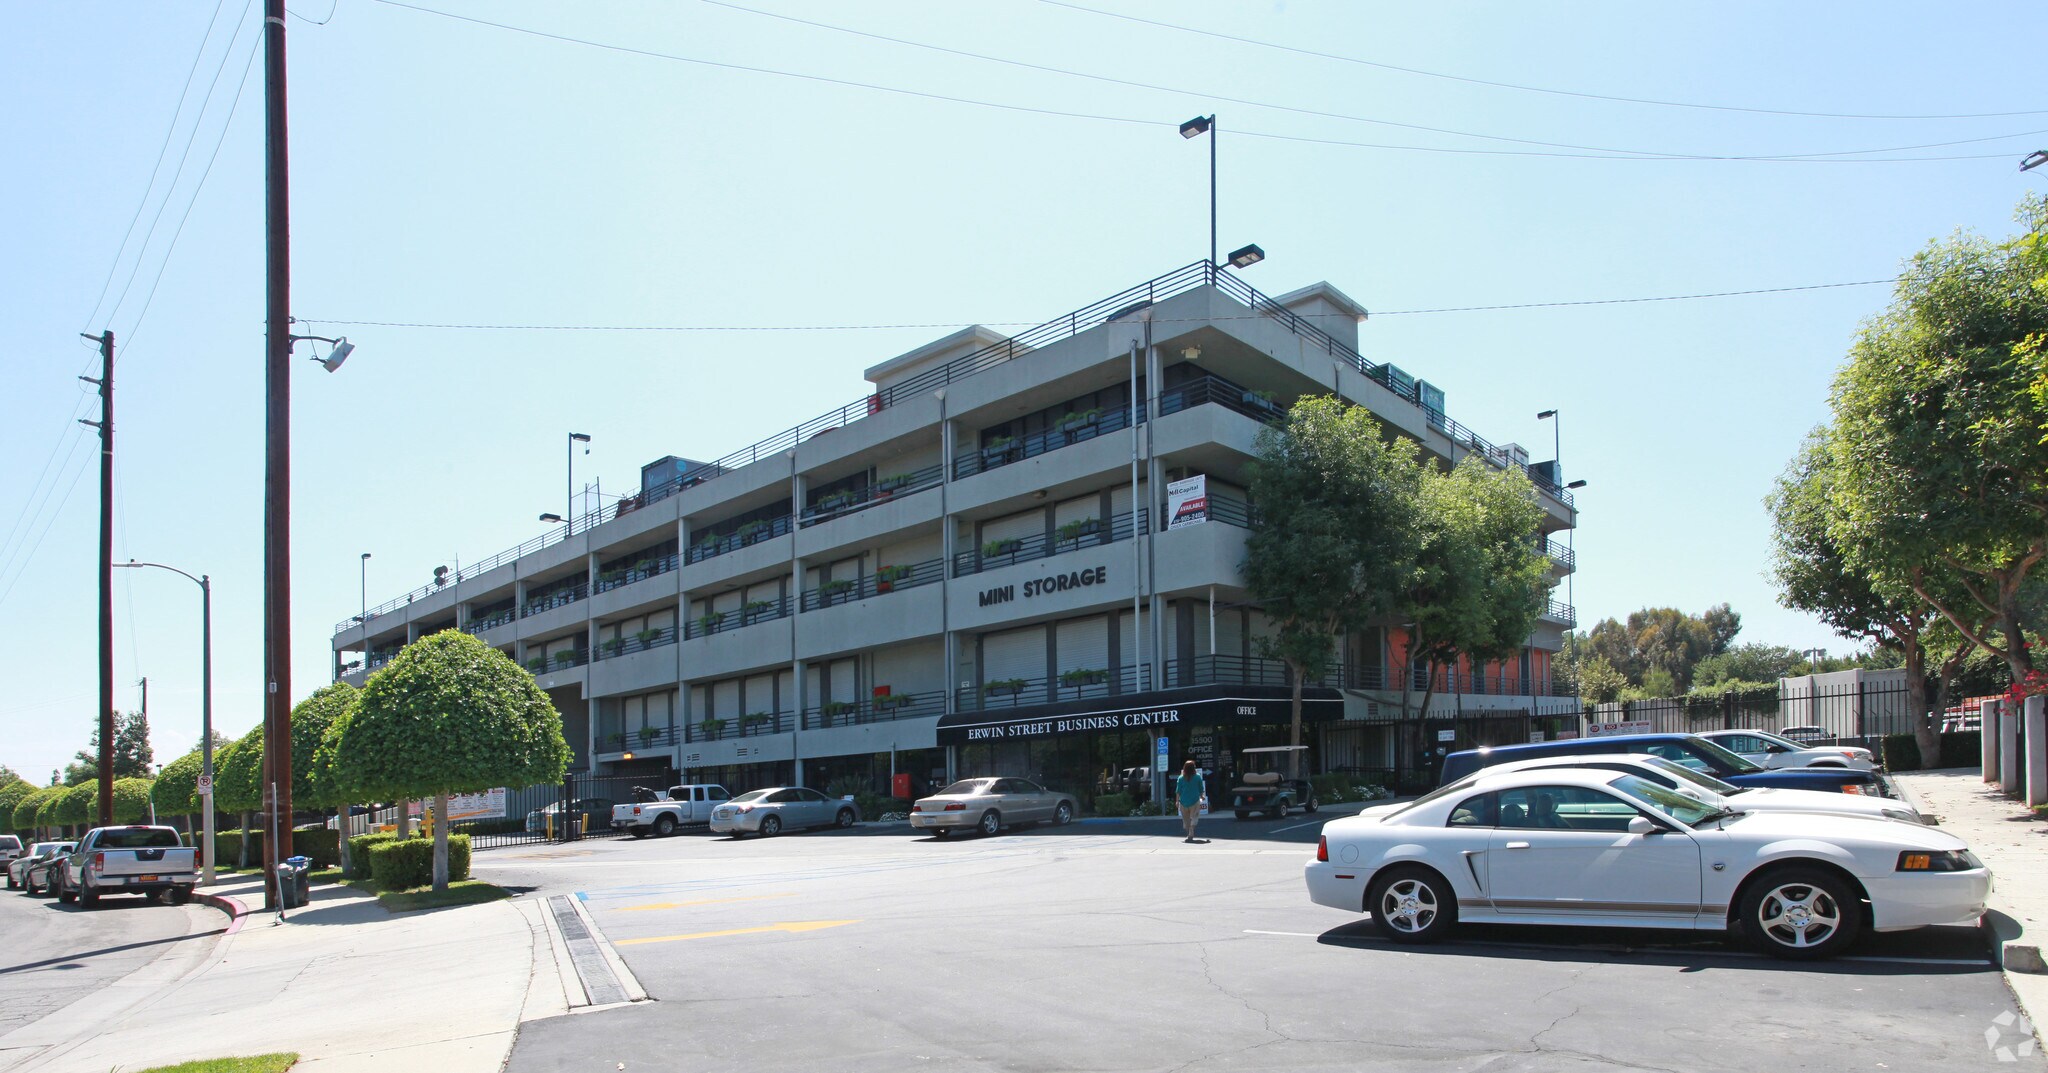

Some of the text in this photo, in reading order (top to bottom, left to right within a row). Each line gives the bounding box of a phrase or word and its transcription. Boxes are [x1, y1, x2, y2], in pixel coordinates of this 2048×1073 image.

[1179, 501, 1204, 512] AVAILABLE
[978, 566, 1106, 607] MINI STORAGE
[1237, 706, 1256, 715] OFFICE
[967, 709, 1180, 740] ERWIN STREET BUSINESS CENTER
[1188, 745, 1213, 754] OFFICE
